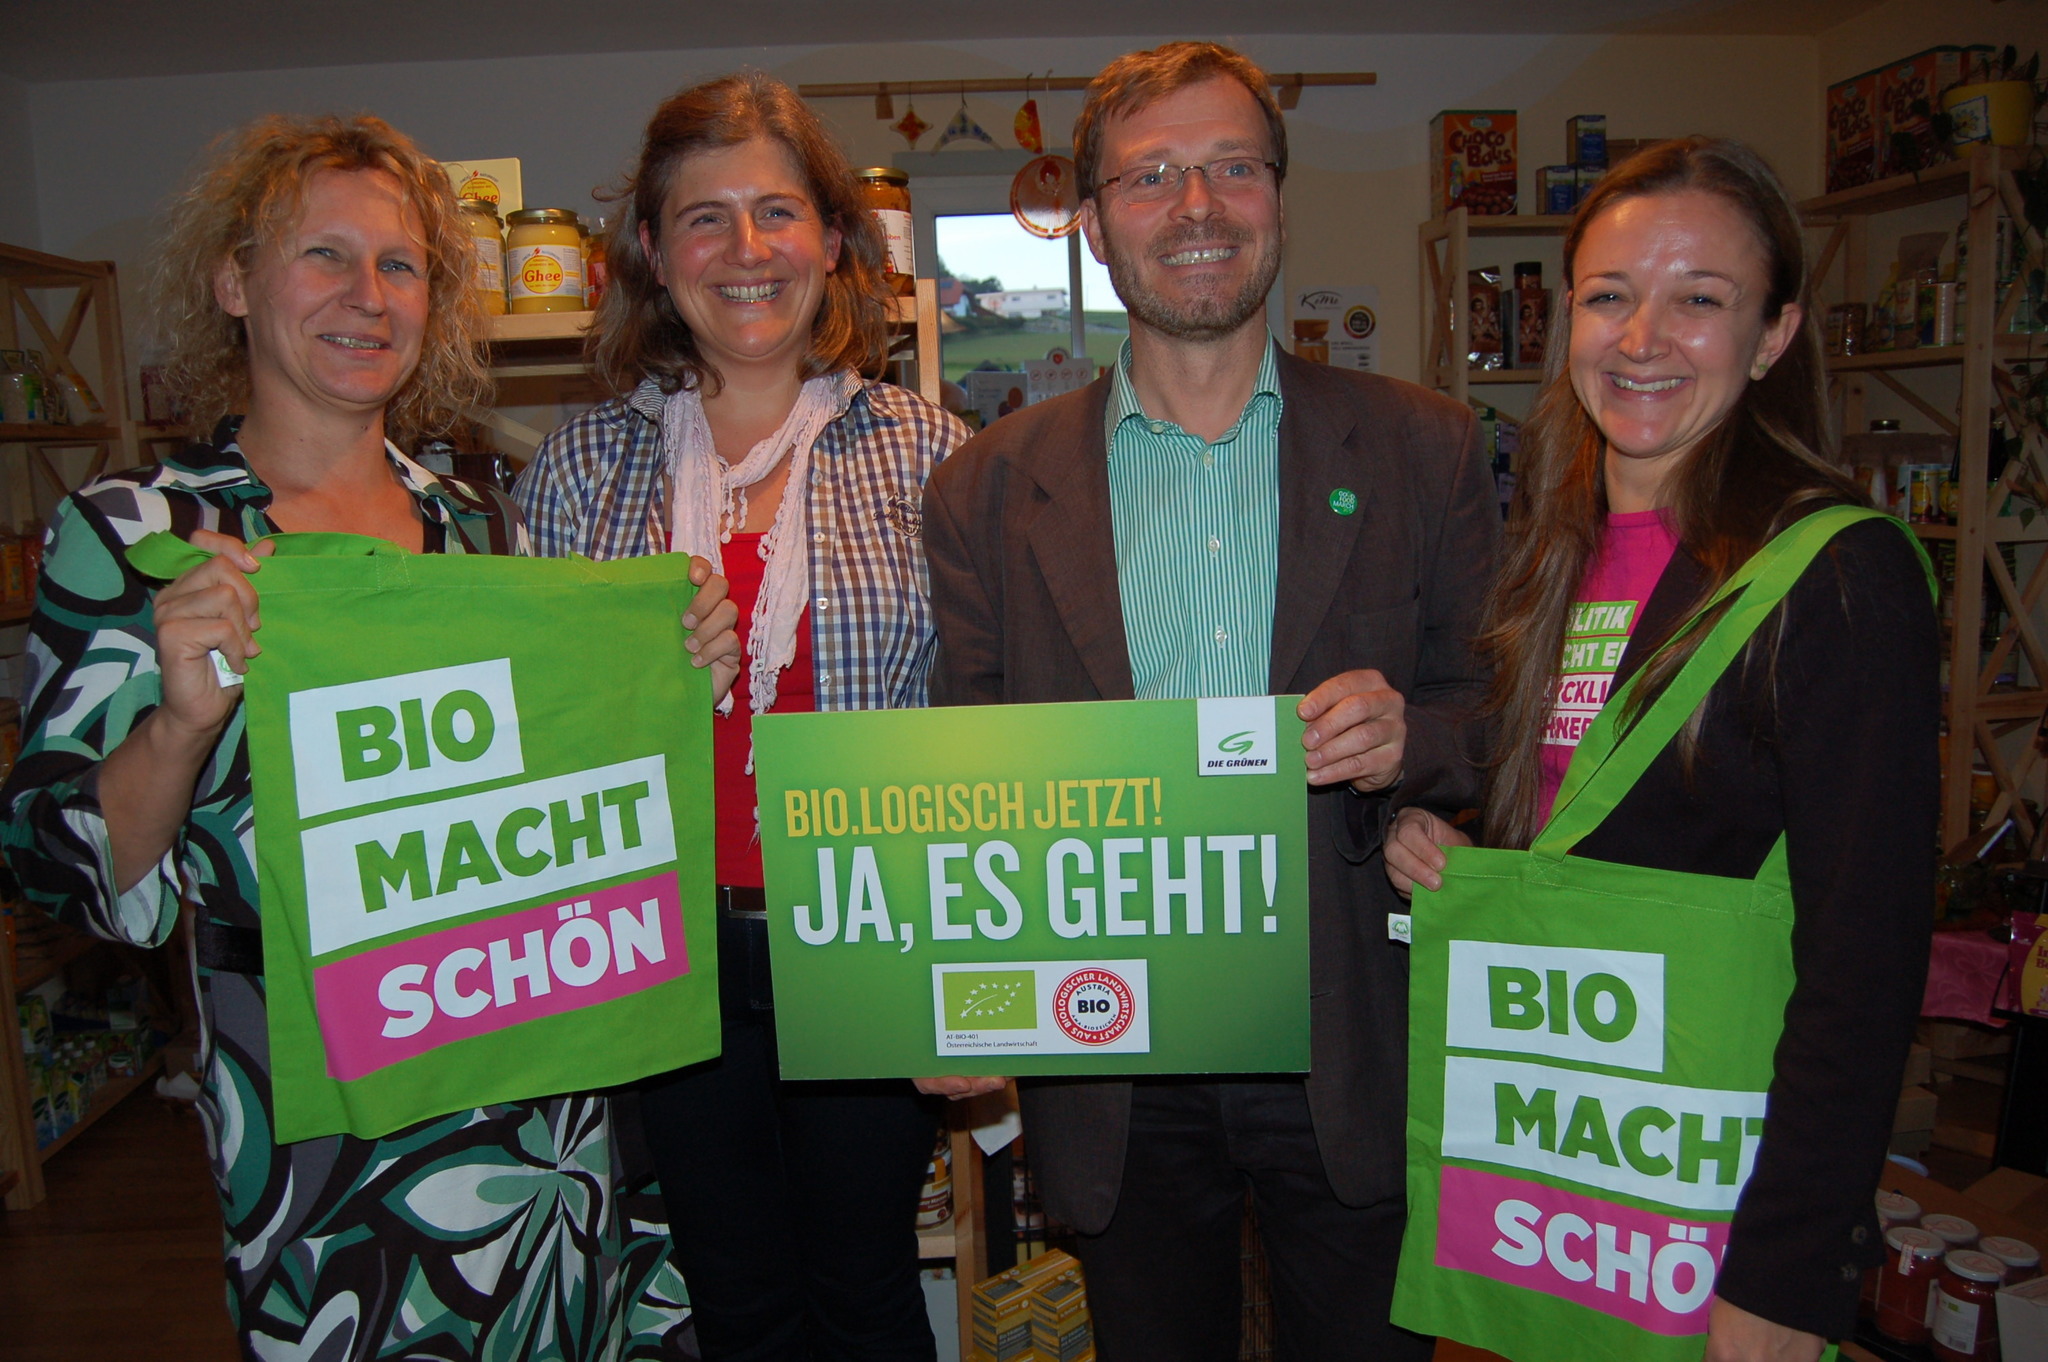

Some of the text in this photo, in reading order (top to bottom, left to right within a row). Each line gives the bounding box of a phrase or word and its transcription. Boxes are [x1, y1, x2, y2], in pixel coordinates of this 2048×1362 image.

[524, 269, 561, 283] Ghee
[336, 689, 495, 782] BIO
[1207, 757, 1268, 768] DIE GRÜNEN
[785, 777, 1163, 837] BIO.LOGISCH JETZT!
[355, 780, 650, 914] MACHT
[793, 834, 1278, 954] JA, ES GEHT!
[378, 897, 666, 1039] SCHÖN
[1076, 983, 1111, 996] AUSTRIA
[1057, 972, 1130, 1041] AUS BIOLOGISCHER LANDWIRTSCHAFT
[1077, 999, 1111, 1014] BIO
[1487, 965, 1637, 1043] BIO
[946, 1040, 1038, 1049] Österreichische Landwirtschaft
[1491, 1198, 1728, 1315] SCHÖ
